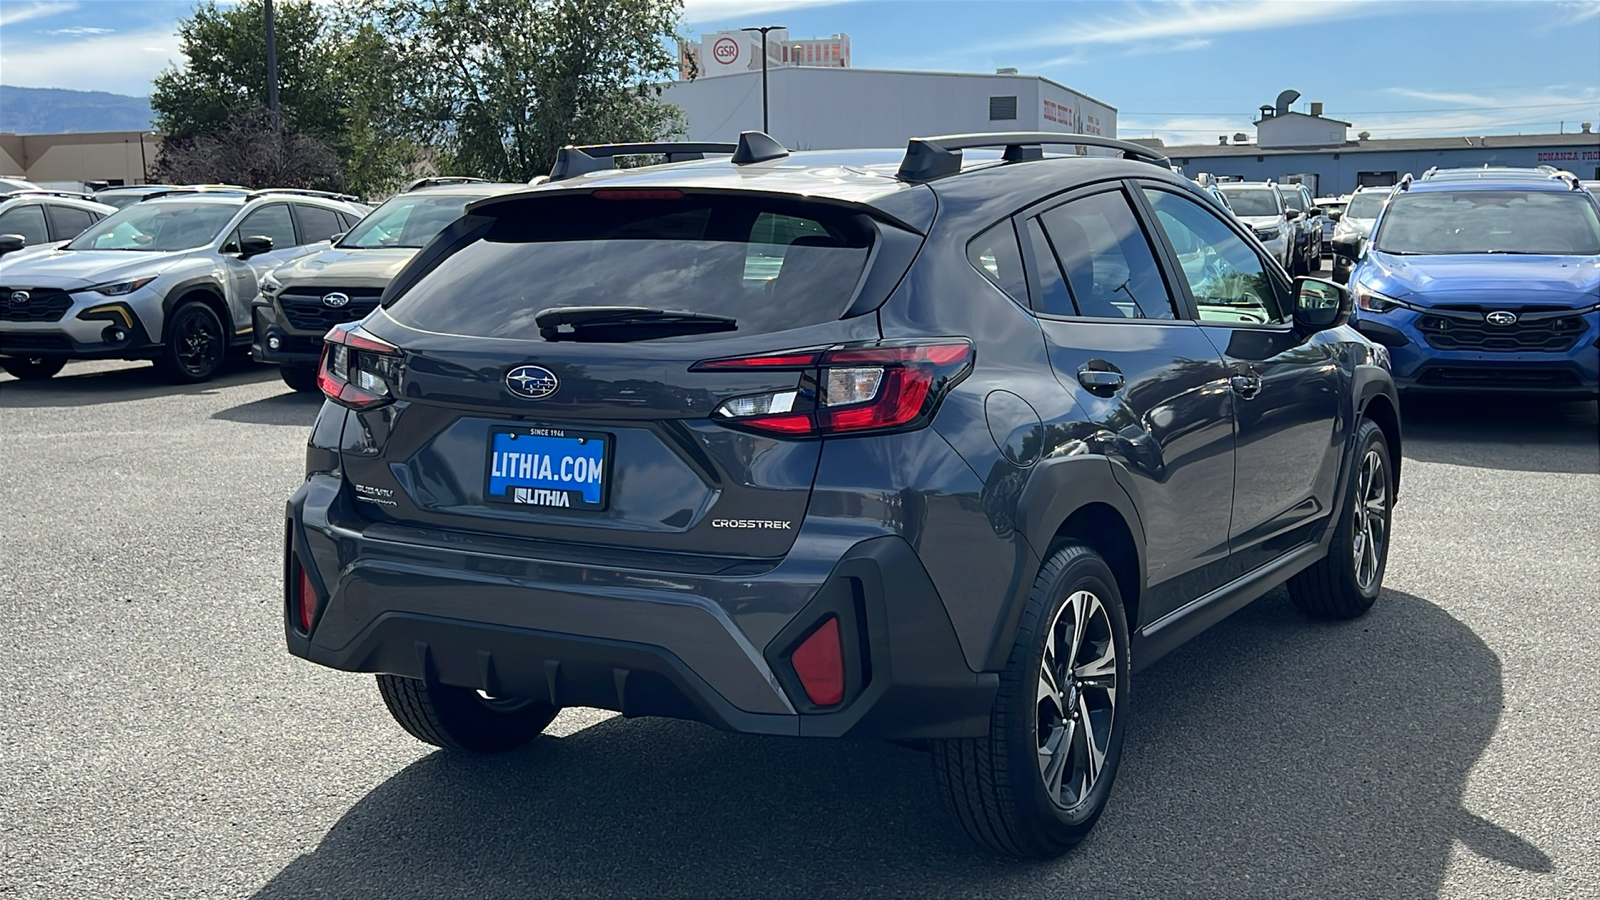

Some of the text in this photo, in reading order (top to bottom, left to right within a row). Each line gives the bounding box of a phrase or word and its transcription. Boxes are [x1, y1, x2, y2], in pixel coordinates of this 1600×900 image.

[716, 45, 735, 57] GSR
[1537, 151, 1600, 162] BONANZA PRO
[530, 428, 565, 437] SINCE 1946
[491, 451, 603, 484] LITHIA.COM
[355, 484, 394, 497] SUBARU
[526, 488, 570, 508] LITHIA
[711, 519, 791, 530] CROSSTREK
